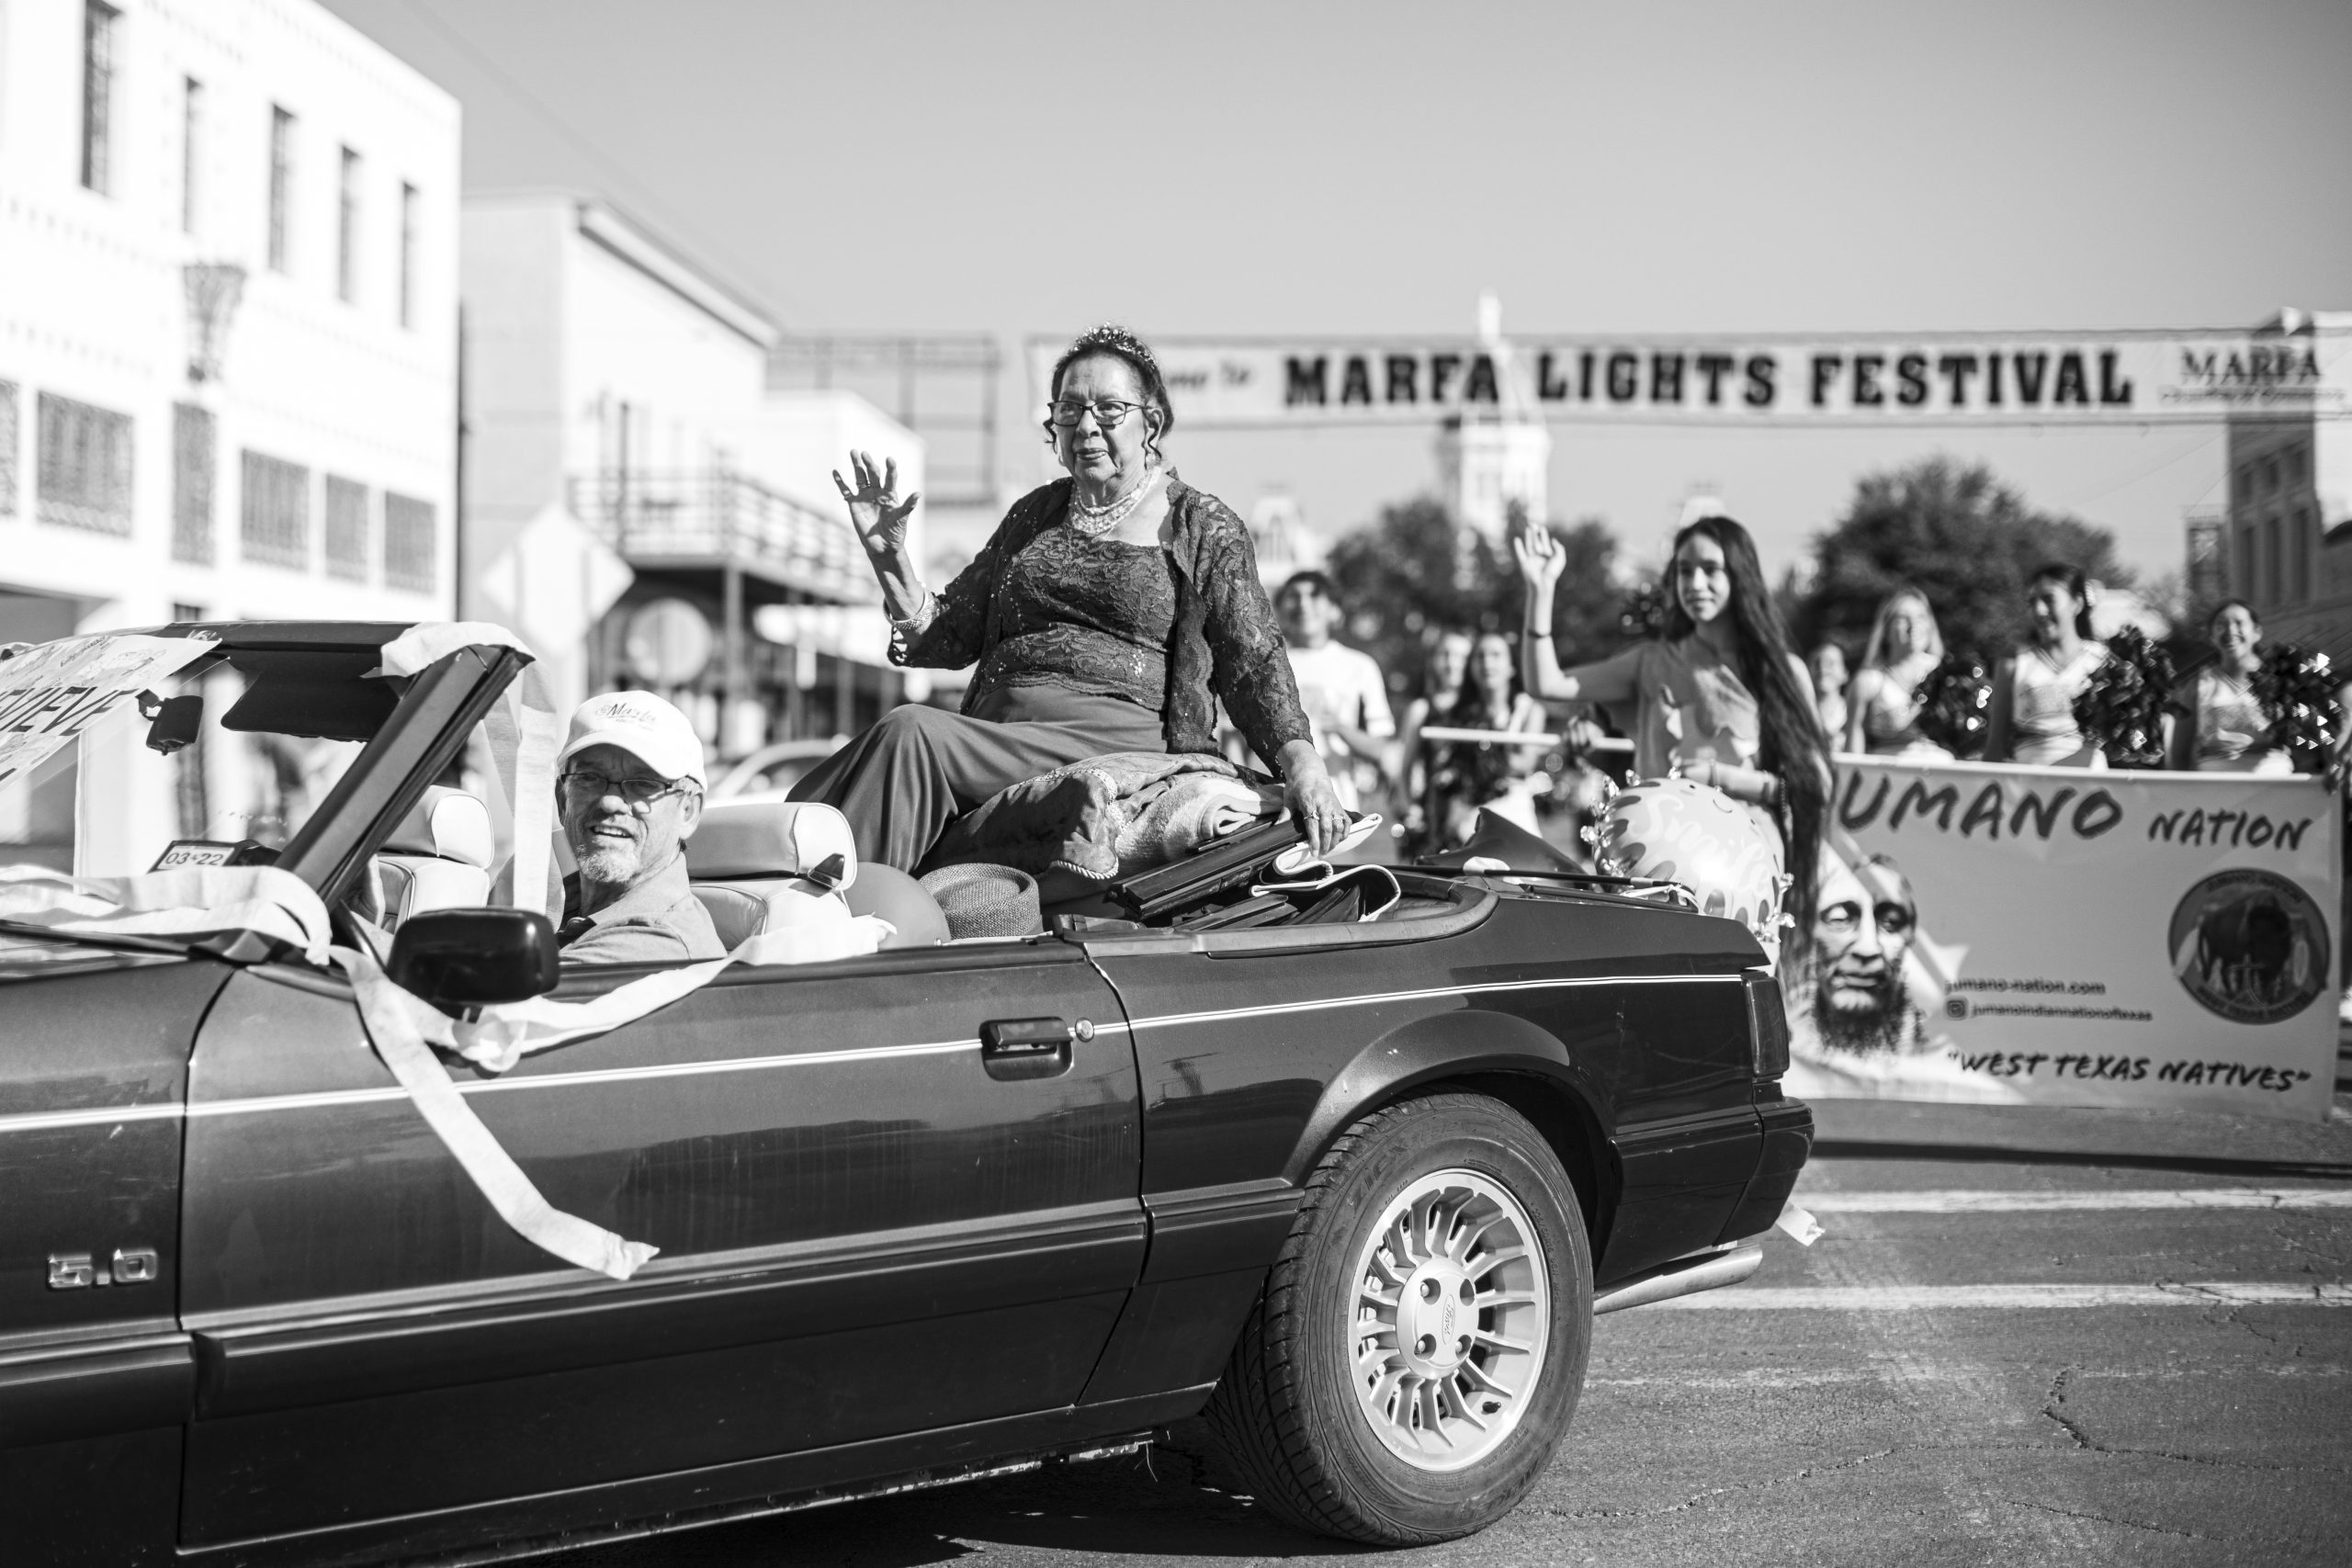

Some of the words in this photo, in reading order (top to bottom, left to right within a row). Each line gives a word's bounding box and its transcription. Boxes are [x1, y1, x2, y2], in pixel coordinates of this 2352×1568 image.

[1283, 353, 1499, 407] MARFA
[1537, 351, 1776, 408] LIGHTS
[1810, 350, 2133, 407] FESTIVAL
[2182, 344, 2321, 385] MARFA
[0, 685, 140, 737] VIEVE
[1837, 769, 2123, 841] UMANO
[2147, 808, 2312, 851] NATION
[2054, 1054, 2151, 1081] TEXAS
[47, 1249, 158, 1288] 5.0
